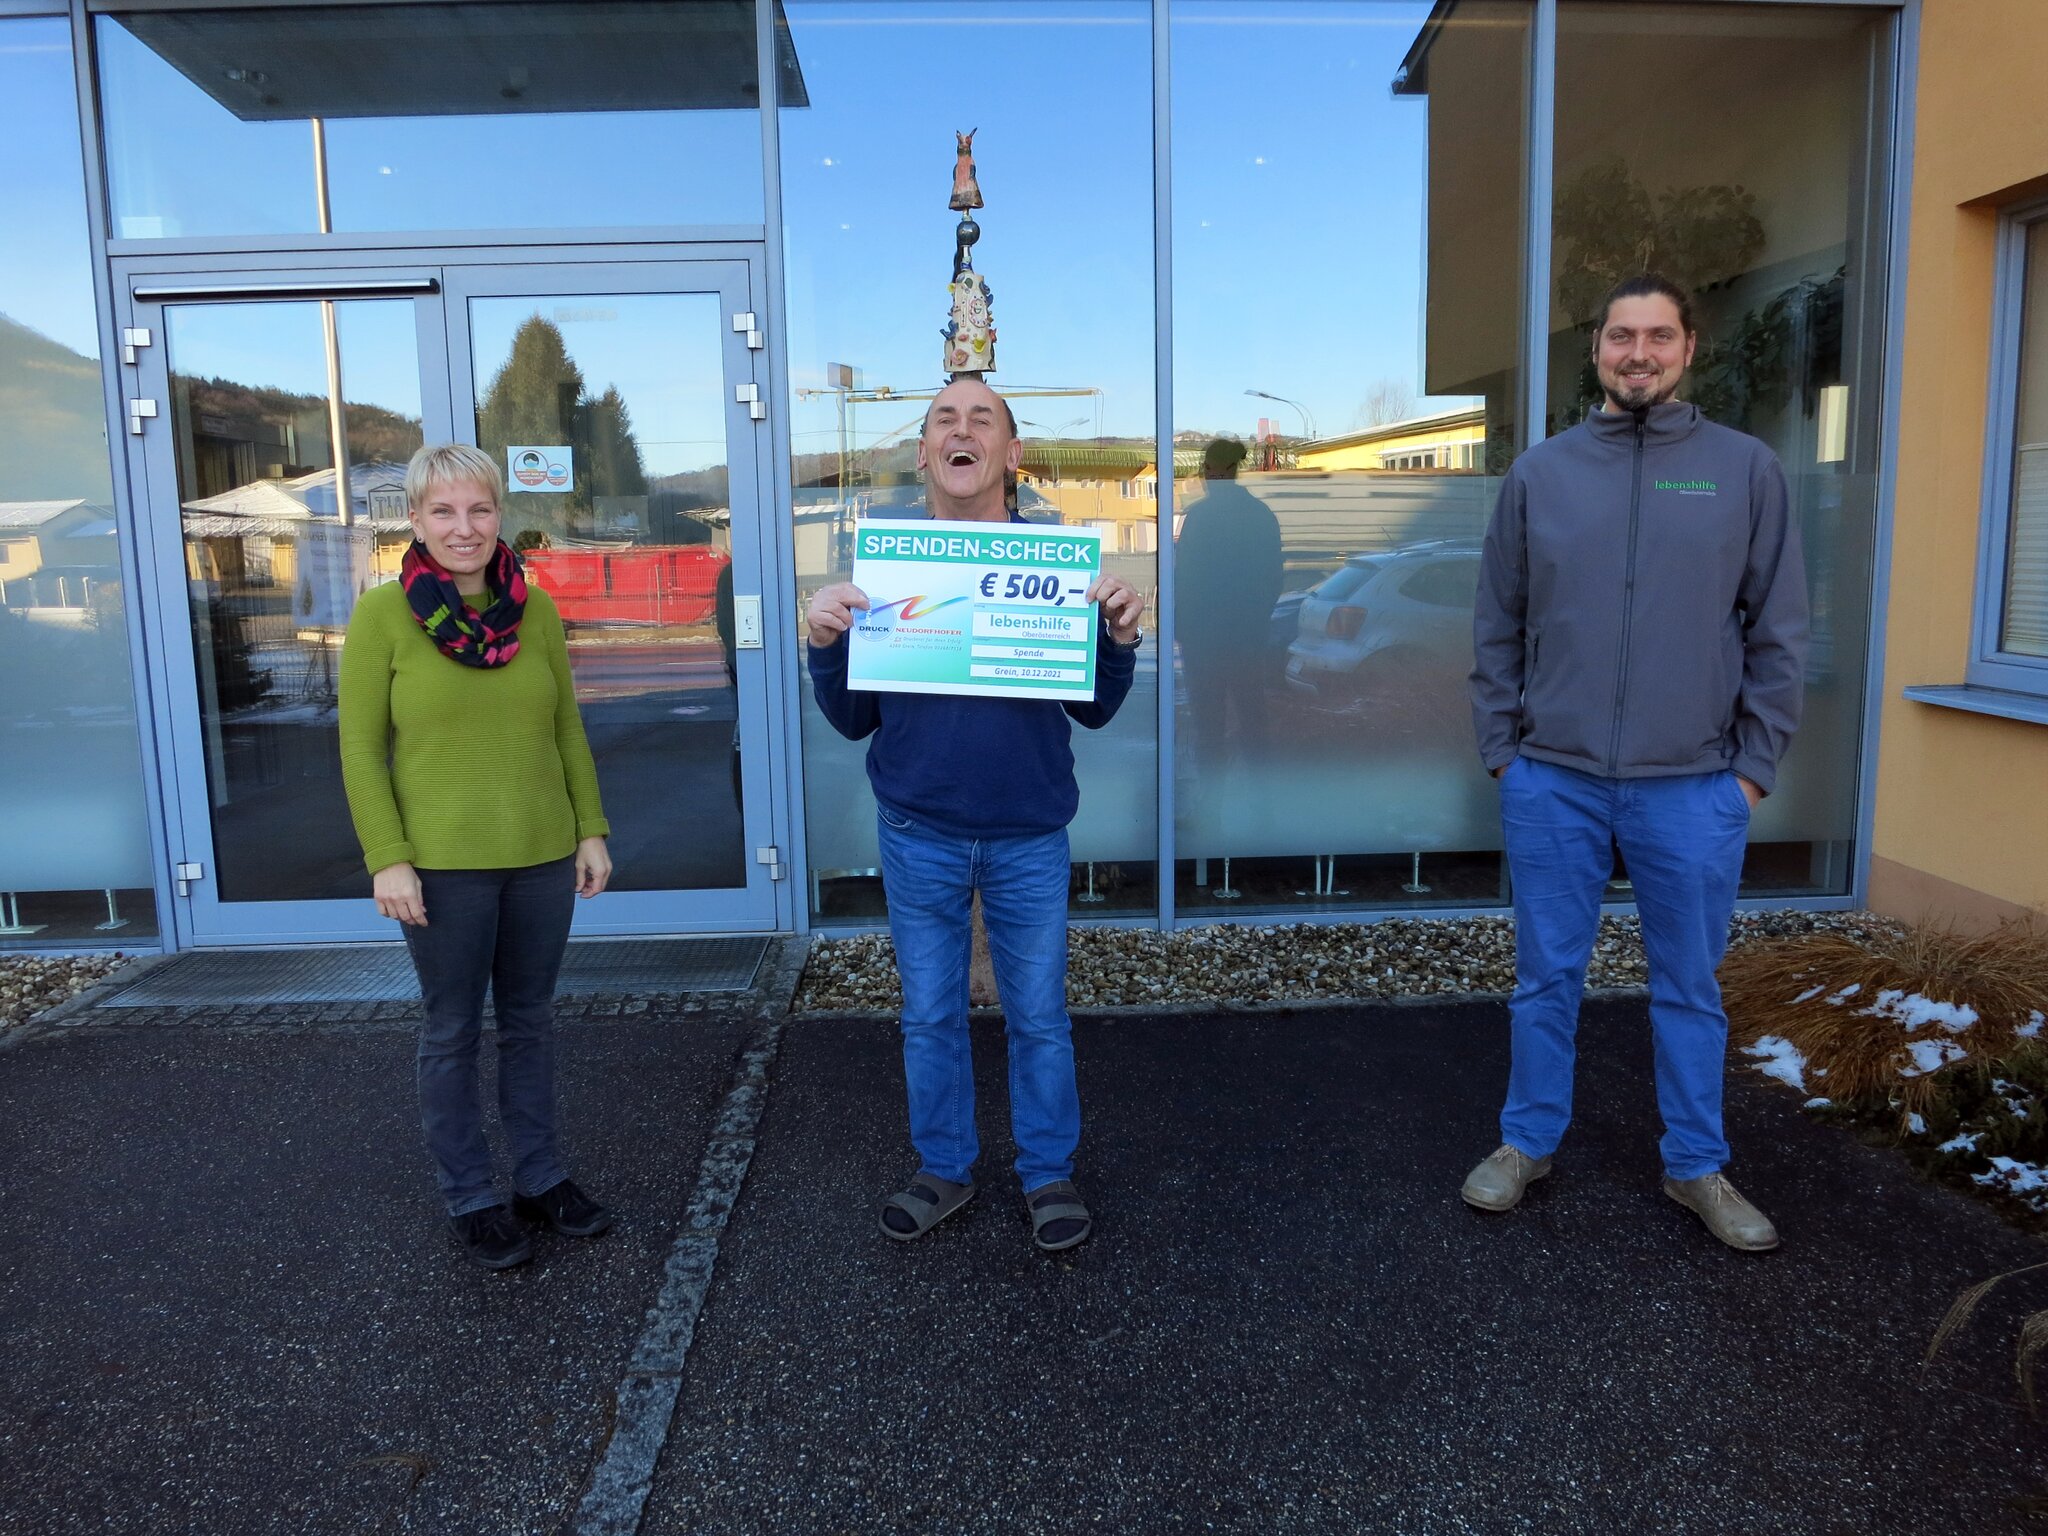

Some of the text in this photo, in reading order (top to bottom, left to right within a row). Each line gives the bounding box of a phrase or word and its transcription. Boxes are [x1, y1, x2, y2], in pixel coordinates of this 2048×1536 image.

[1655, 480, 1716, 490] lebenshilfe
[864, 535, 1092, 564] SPENDEN-SCHECK
[980, 572, 998, 598] €
[990, 614, 1071, 631] lebenshilfe
[859, 625, 962, 636] DRUCK NEUDORFHOFER
[1022, 630, 1071, 640] Oberösterreich
[1013, 648, 1044, 658] Spende
[994, 667, 1061, 678] Grein, 10.12.2021
